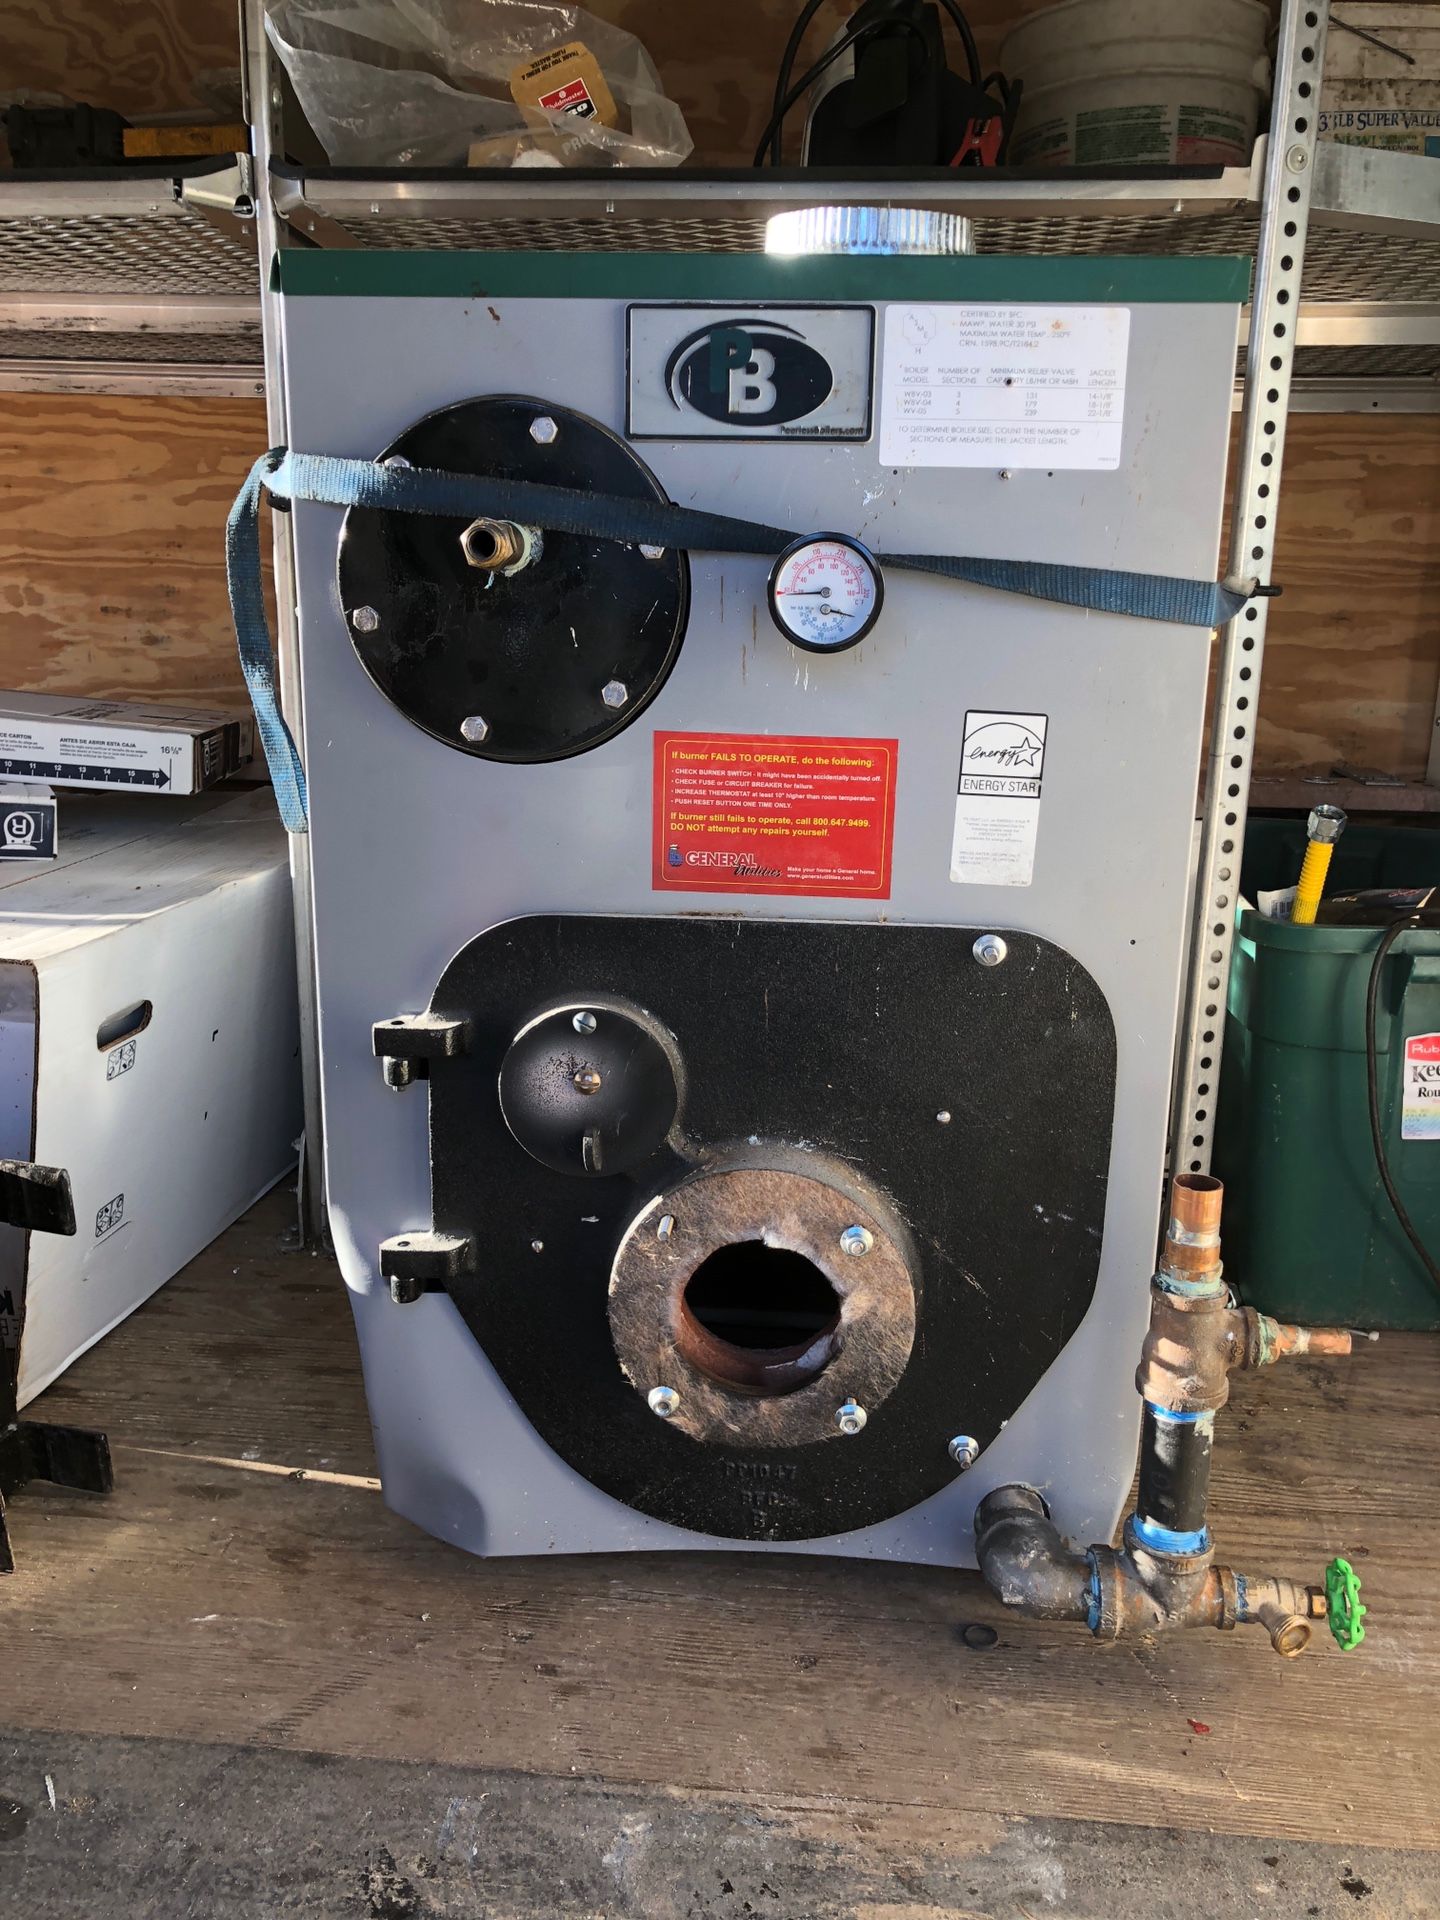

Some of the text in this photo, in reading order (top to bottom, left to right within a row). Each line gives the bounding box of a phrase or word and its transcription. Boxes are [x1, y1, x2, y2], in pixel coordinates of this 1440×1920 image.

[1356, 112, 1399, 131] SUPER
[710, 753, 736, 761] FAILS
[753, 754, 799, 765] OPERATE,
[831, 757, 875, 768] following:
[964, 779, 1036, 793] ENERGY STAR
[758, 817, 793, 826] operate,
[813, 818, 871, 827] 800.647.9499.
[707, 826, 740, 834] attempt
[742, 827, 758, 835] any
[792, 828, 830, 837] yourself.
[686, 850, 757, 868] GENERAL
